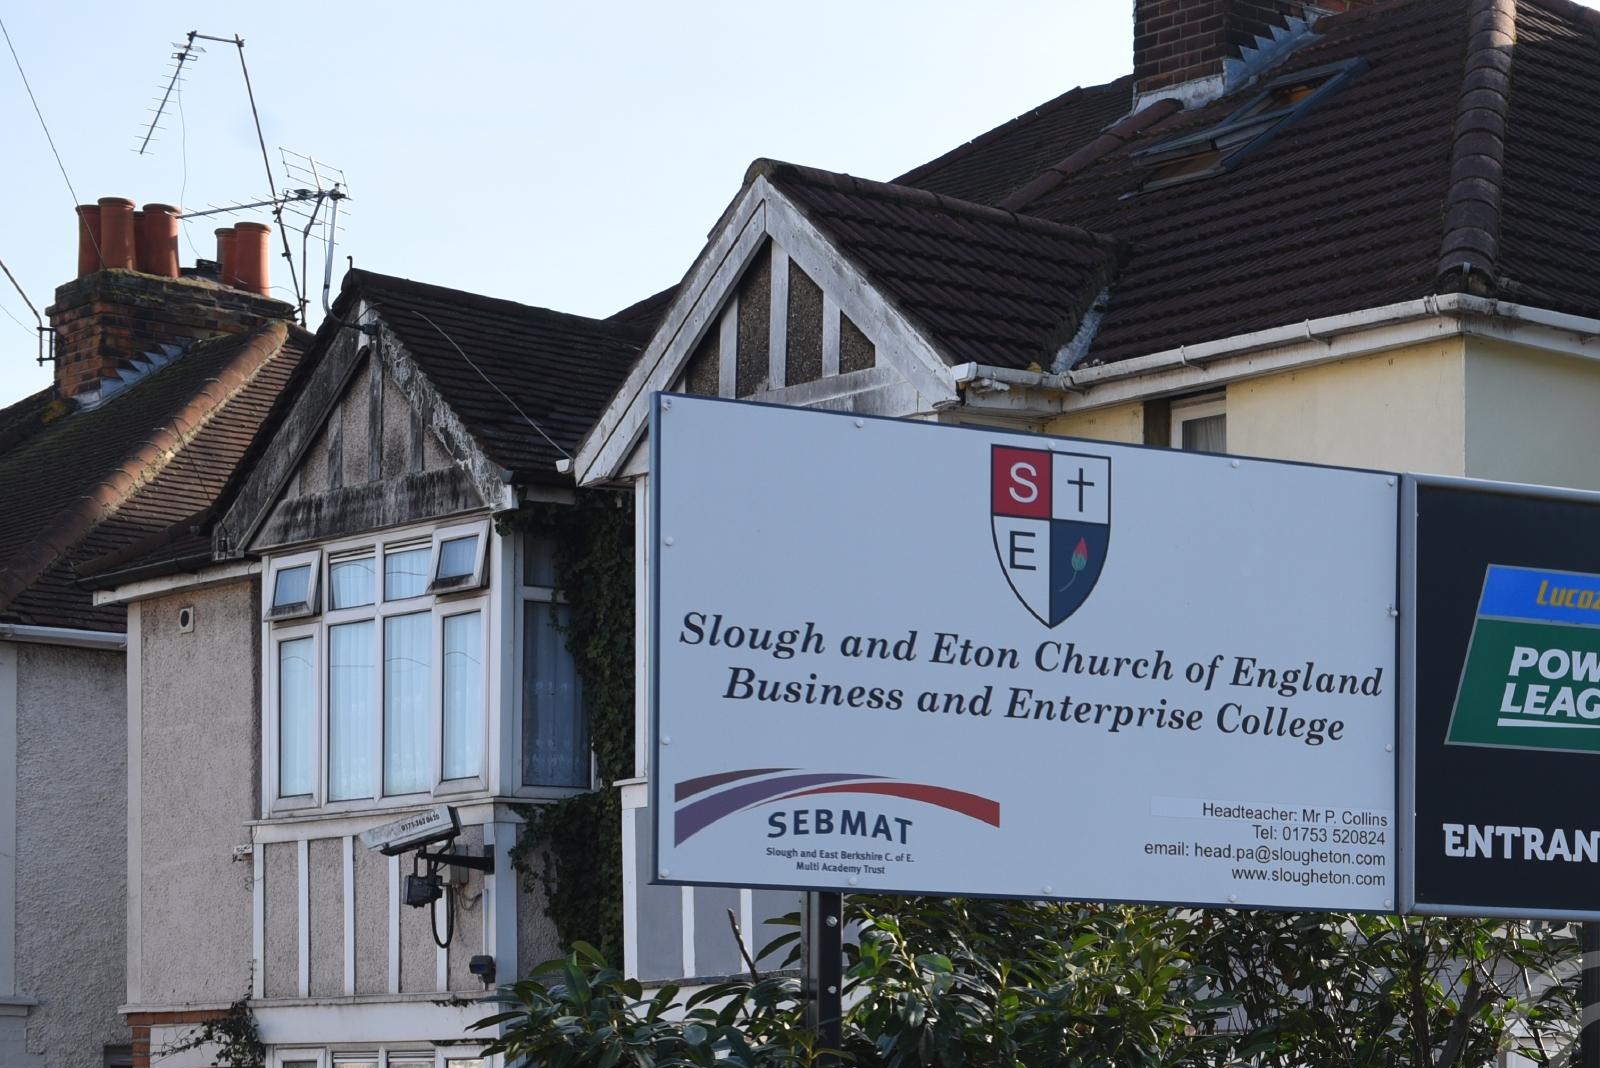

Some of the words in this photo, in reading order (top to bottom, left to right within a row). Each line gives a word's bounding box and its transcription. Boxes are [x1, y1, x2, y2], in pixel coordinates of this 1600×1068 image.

[1008, 461, 1039, 503] S
[1009, 529, 1037, 571] E
[679, 611, 826, 660] Slough
[840, 630, 918, 661] and
[928, 632, 1020, 669] Eton
[1034, 640, 1173, 681] Church
[1185, 654, 1225, 692] of
[1229, 656, 1384, 698] England
[722, 666, 904, 710] Business
[917, 685, 993, 717] and
[1003, 686, 1203, 732] Enterprise
[1216, 702, 1345, 746] College
[767, 808, 913, 844] SEBMAT
[1202, 802, 1297, 822] Headteacher:
[1302, 809, 1321, 823] Mr
[1325, 810, 1337, 824] P.
[1342, 811, 1388, 826] Collins
[1252, 824, 1277, 840] Tel:
[1282, 826, 1328, 843] 01753
[1332, 829, 1386, 845] 520824
[766, 847, 798, 859] Slough
[800, 848, 817, 858] and
[819, 849, 838, 859] East
[841, 850, 883, 861] Berkshire
[884, 852, 893, 862] C.
[895, 853, 904, 862] of
[906, 853, 915, 862] E.
[1144, 841, 1189, 857] email:
[1194, 842, 1386, 866] head.pa@slougheton.com
[796, 861, 819, 871] Multi
[821, 862, 862, 875] Academy
[863, 864, 885, 874] Trust
[1231, 867, 1386, 886] www.slougheton.com
